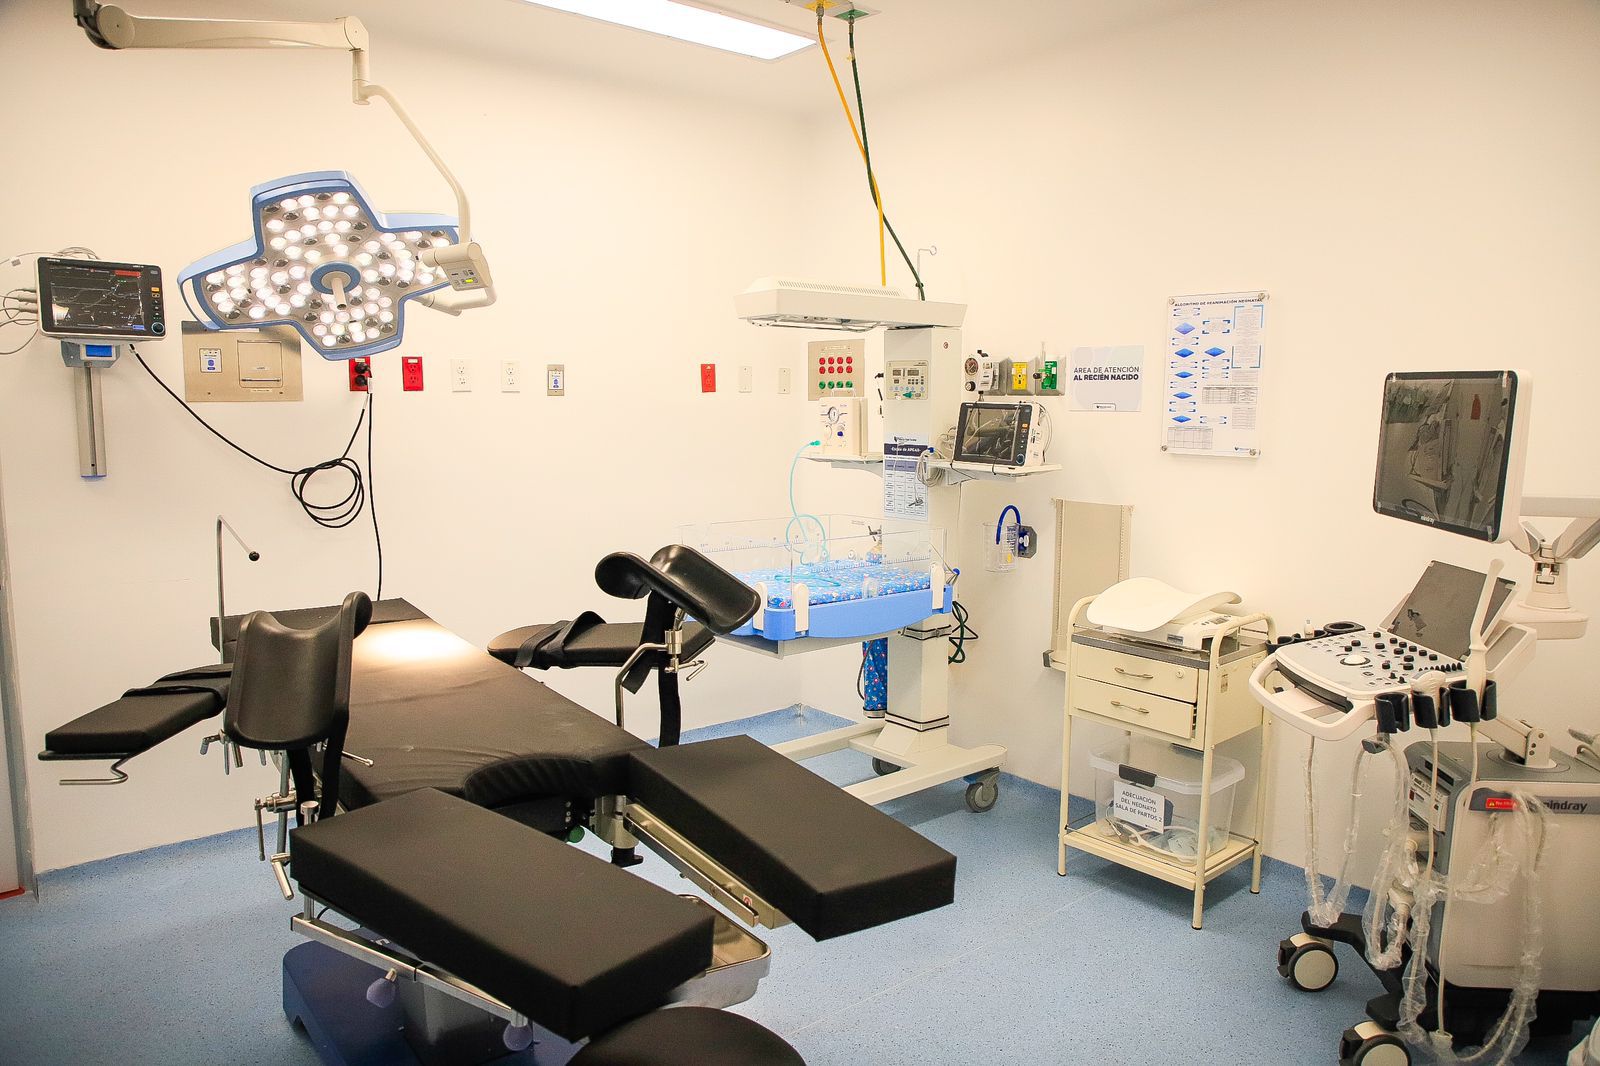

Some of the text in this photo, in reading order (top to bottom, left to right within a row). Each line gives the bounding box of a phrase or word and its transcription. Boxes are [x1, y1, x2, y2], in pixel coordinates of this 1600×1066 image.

[1115, 803, 1128, 811] SALA
[1138, 810, 1157, 820] PARTOS
[1132, 800, 1156, 813] NEONATO
